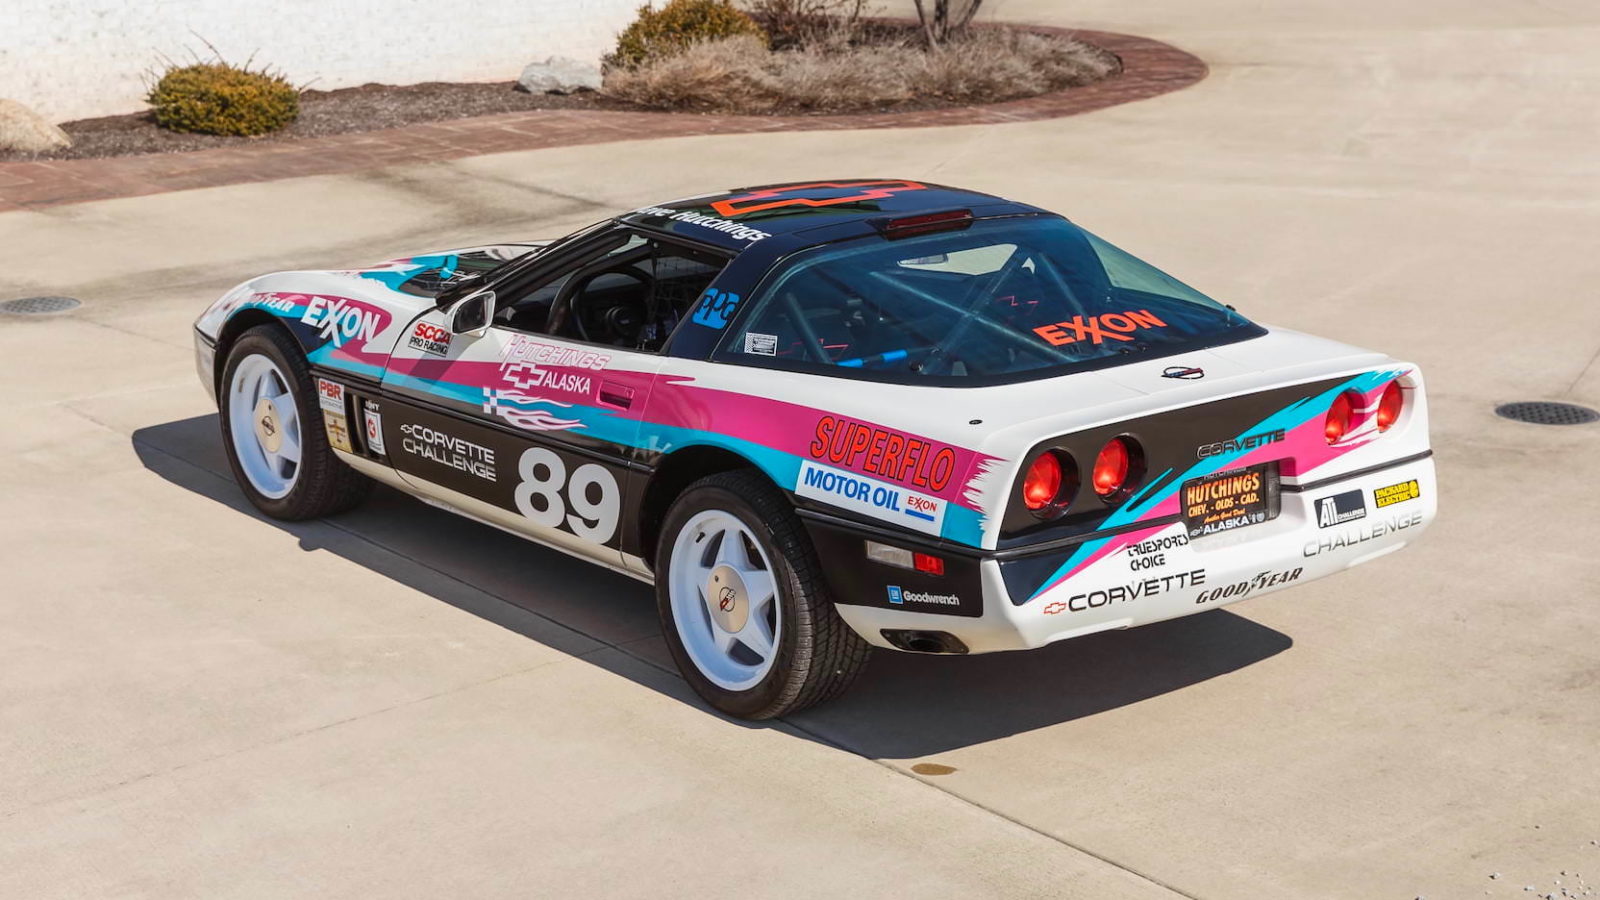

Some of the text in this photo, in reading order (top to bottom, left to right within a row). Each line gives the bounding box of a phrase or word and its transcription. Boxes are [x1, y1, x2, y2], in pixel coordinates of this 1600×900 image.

[636, 206, 772, 241] ave Hutchings
[301, 294, 381, 347] EXXON
[415, 323, 450, 344] SCCA
[1032, 309, 1167, 346] EXXON
[410, 337, 448, 354] PRO RACING
[499, 334, 611, 371] HUTCHINGS
[320, 380, 342, 400] PBR
[543, 371, 591, 395] ALASKA
[402, 437, 497, 482] CHALLENGE
[412, 424, 495, 465] CORVETTE
[810, 416, 955, 492] SUPERFLO
[1197, 428, 1285, 460] CORVETTE
[514, 447, 620, 545] 89
[804, 467, 938, 512] MOTOR OIL EXXON
[1187, 473, 1260, 505] HUTCHINGS
[1215, 497, 1234, 510] OLDS
[1203, 515, 1250, 534] ALASKA
[1304, 511, 1422, 558] CHALLENGE
[1126, 534, 1189, 556] TRUESPORTS
[1130, 553, 1166, 571] CHOICE
[903, 590, 960, 605] Goodwrench
[1068, 569, 1206, 612] CORVETTE
